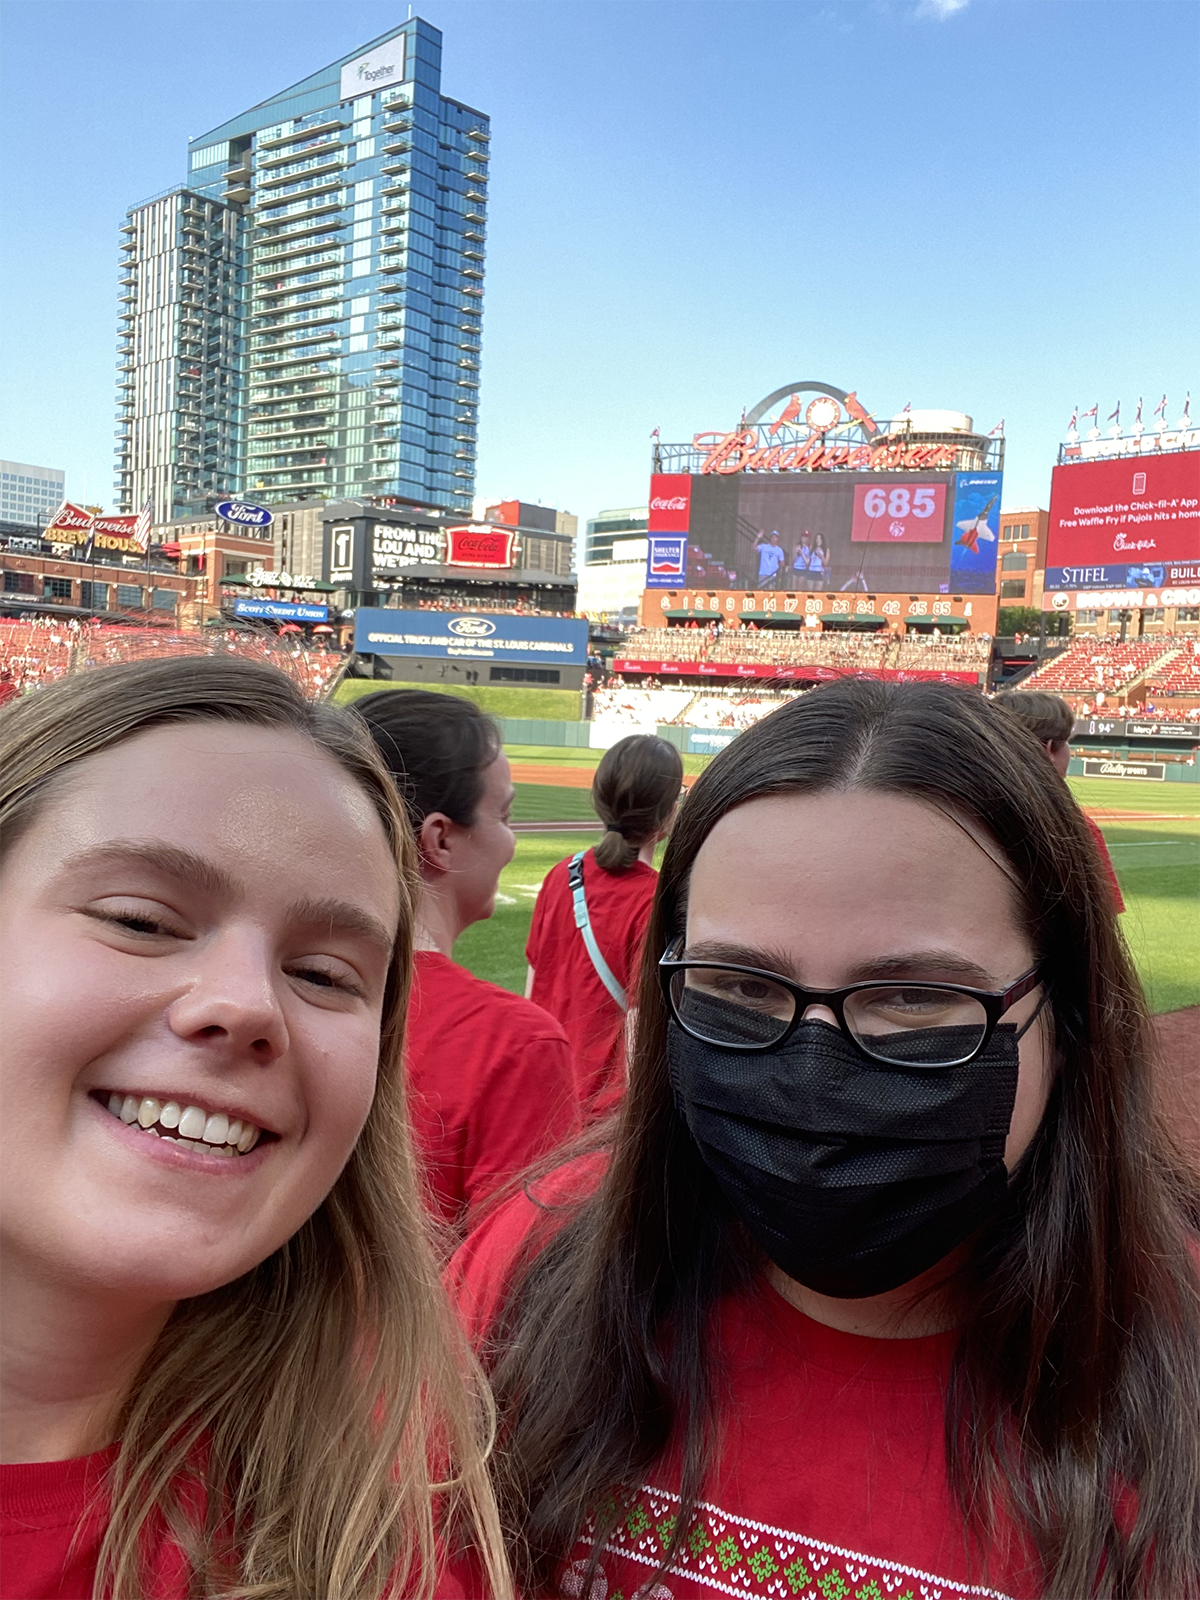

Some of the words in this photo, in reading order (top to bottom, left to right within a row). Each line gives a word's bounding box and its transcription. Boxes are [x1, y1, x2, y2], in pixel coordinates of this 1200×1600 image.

[363, 65, 395, 81] Together
[692, 429, 961, 475] Budweiser
[650, 496, 688, 510] Coca-Cola
[863, 487, 936, 519] 685
[1073, 504, 1114, 516] Download
[1114, 503, 1129, 513] the
[1180, 498, 1198, 509] App
[52, 508, 137, 535] Budweise
[227, 503, 264, 523] Ford
[1059, 519, 1077, 528] Free
[1078, 516, 1104, 527] Waffle
[1105, 515, 1119, 526] Fry
[1120, 514, 1126, 523] if
[1127, 513, 1152, 525] Pujols
[1153, 511, 1170, 521] hits
[44, 527, 89, 546] BREW
[374, 524, 417, 543] FROM
[373, 538, 403, 555] LOU
[403, 542, 436, 558] AND
[457, 536, 500, 552] Coca-Cola
[654, 546, 680, 554] SHELTER
[1061, 567, 1109, 584] STIFEL
[296, 606, 326, 618] UNION
[682, 596, 689, 610] 1
[694, 597, 704, 611] 2
[725, 597, 735, 612] 9
[742, 597, 756, 612] 10
[763, 598, 777, 612] 14
[784, 598, 798, 613] 17
[805, 598, 823, 613] 20
[832, 600, 850, 614] 23
[856, 600, 875, 614] 24
[882, 601, 900, 615] 42
[908, 601, 928, 616] 45
[932, 601, 951, 616] 85
[455, 619, 488, 634] Ford
[367, 632, 404, 644] OFFICIAL
[404, 634, 431, 645] TRUCK
[431, 636, 449, 646] AND
[448, 636, 465, 647] CAR
[465, 638, 477, 648] OF
[477, 639, 493, 649] THE
[505, 640, 529, 650] LOUIS
[529, 641, 574, 653] CARDINALS
[1133, 725, 1152, 735] Mercy
[1100, 762, 1127, 776] Bally
[1126, 767, 1148, 776] SPORTS
